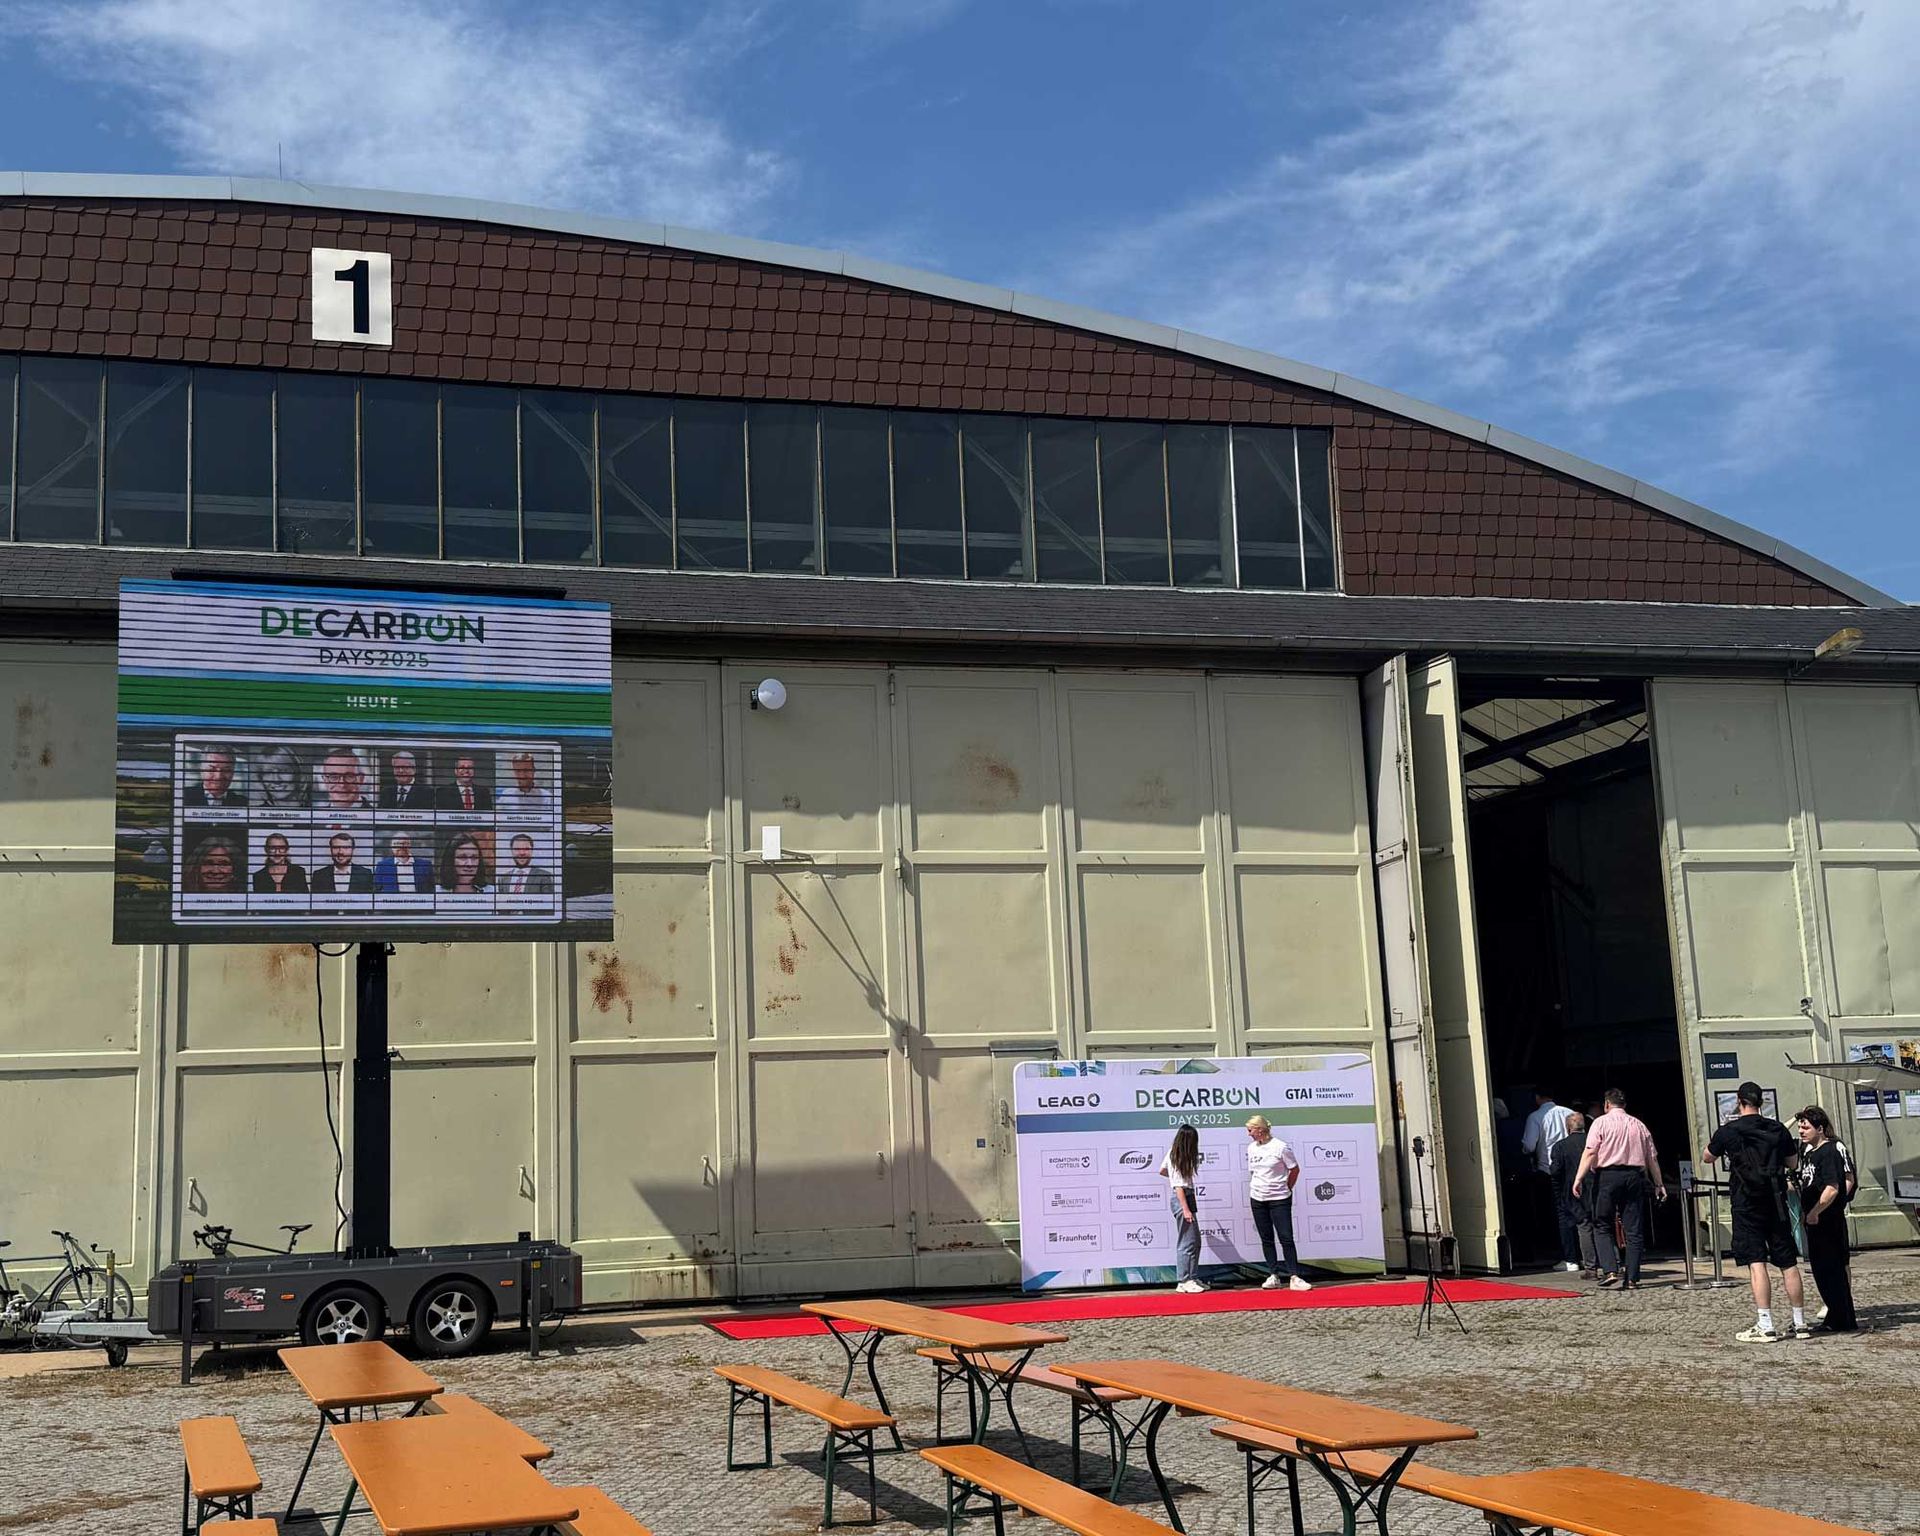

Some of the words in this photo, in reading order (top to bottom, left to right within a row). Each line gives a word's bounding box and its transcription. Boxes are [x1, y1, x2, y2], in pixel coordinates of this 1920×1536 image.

[335, 260, 369, 334] 1
[261, 606, 484, 643] DECARBON
[347, 695, 398, 708] HEUTE
[1136, 1087, 1260, 1108] DECARBON
[1285, 1088, 1312, 1099] GTAI
[1038, 1096, 1085, 1107] LEAG
[1325, 1150, 1344, 1160] evp
[1320, 1186, 1335, 1196] kei
[1059, 1233, 1097, 1242] Fraunhofer
